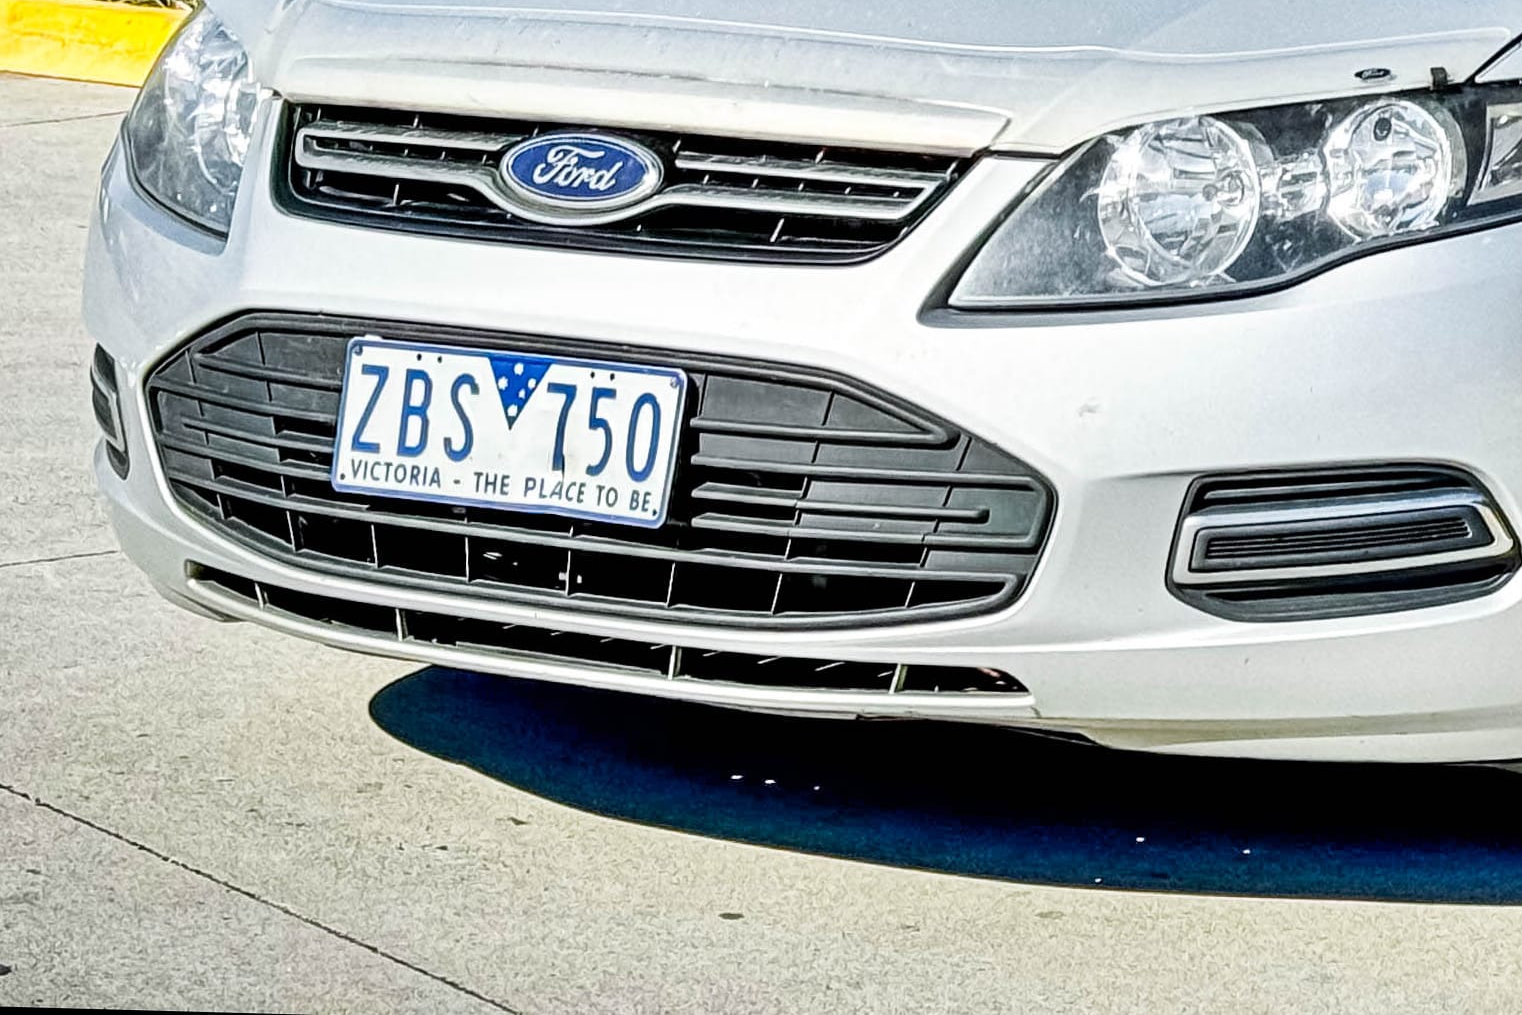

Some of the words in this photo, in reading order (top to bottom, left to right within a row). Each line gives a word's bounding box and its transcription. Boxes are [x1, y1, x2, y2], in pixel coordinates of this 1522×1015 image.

[532, 144, 623, 191] Ford
[351, 364, 480, 462] ZBS
[547, 382, 662, 483] 750
[351, 459, 441, 489] VICTORIA
[474, 471, 510, 496] THE
[524, 477, 585, 505] PLACE
[595, 488, 618, 508] TO
[629, 490, 652, 512] BE
